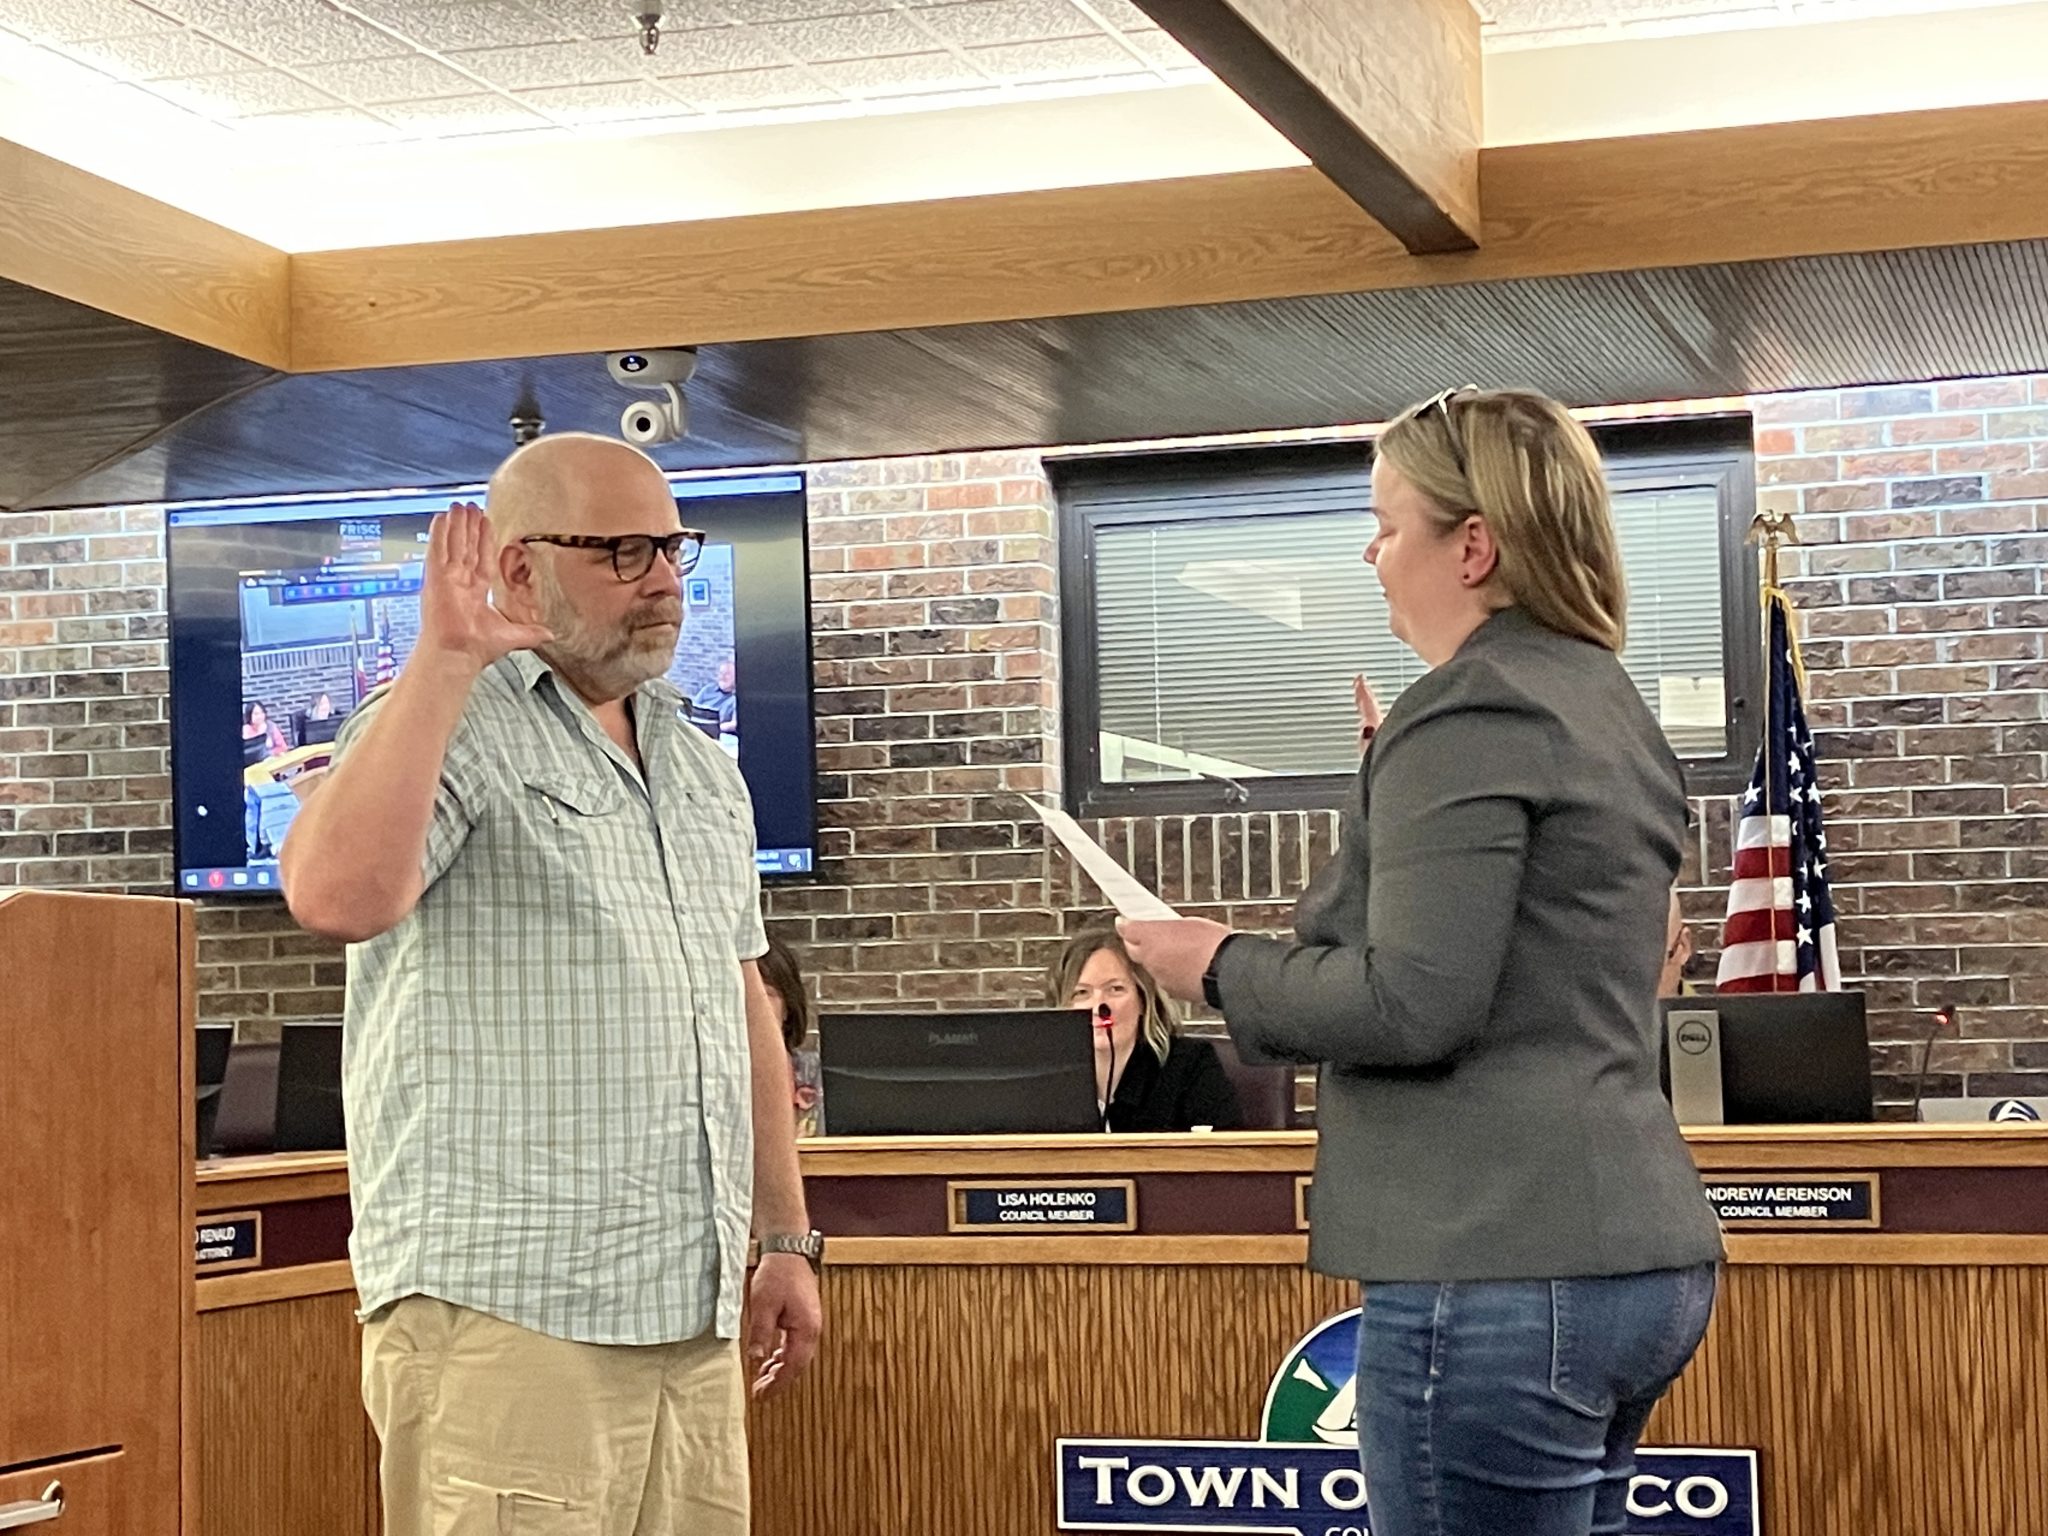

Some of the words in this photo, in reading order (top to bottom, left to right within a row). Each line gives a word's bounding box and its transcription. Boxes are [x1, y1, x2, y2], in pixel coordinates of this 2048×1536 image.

[997, 1192, 1028, 1206] LISA
[1029, 1192, 1096, 1206] HOLENKO
[1705, 1187, 1764, 1201] NDREW
[1765, 1187, 1852, 1201] AERENSON
[1000, 1209, 1047, 1221] COUNCIL
[1047, 1209, 1095, 1221] MEMBER
[1720, 1205, 1773, 1217] COUNCIL
[1775, 1205, 1828, 1217] MEMBER
[1320, 1468, 1369, 1511] O
